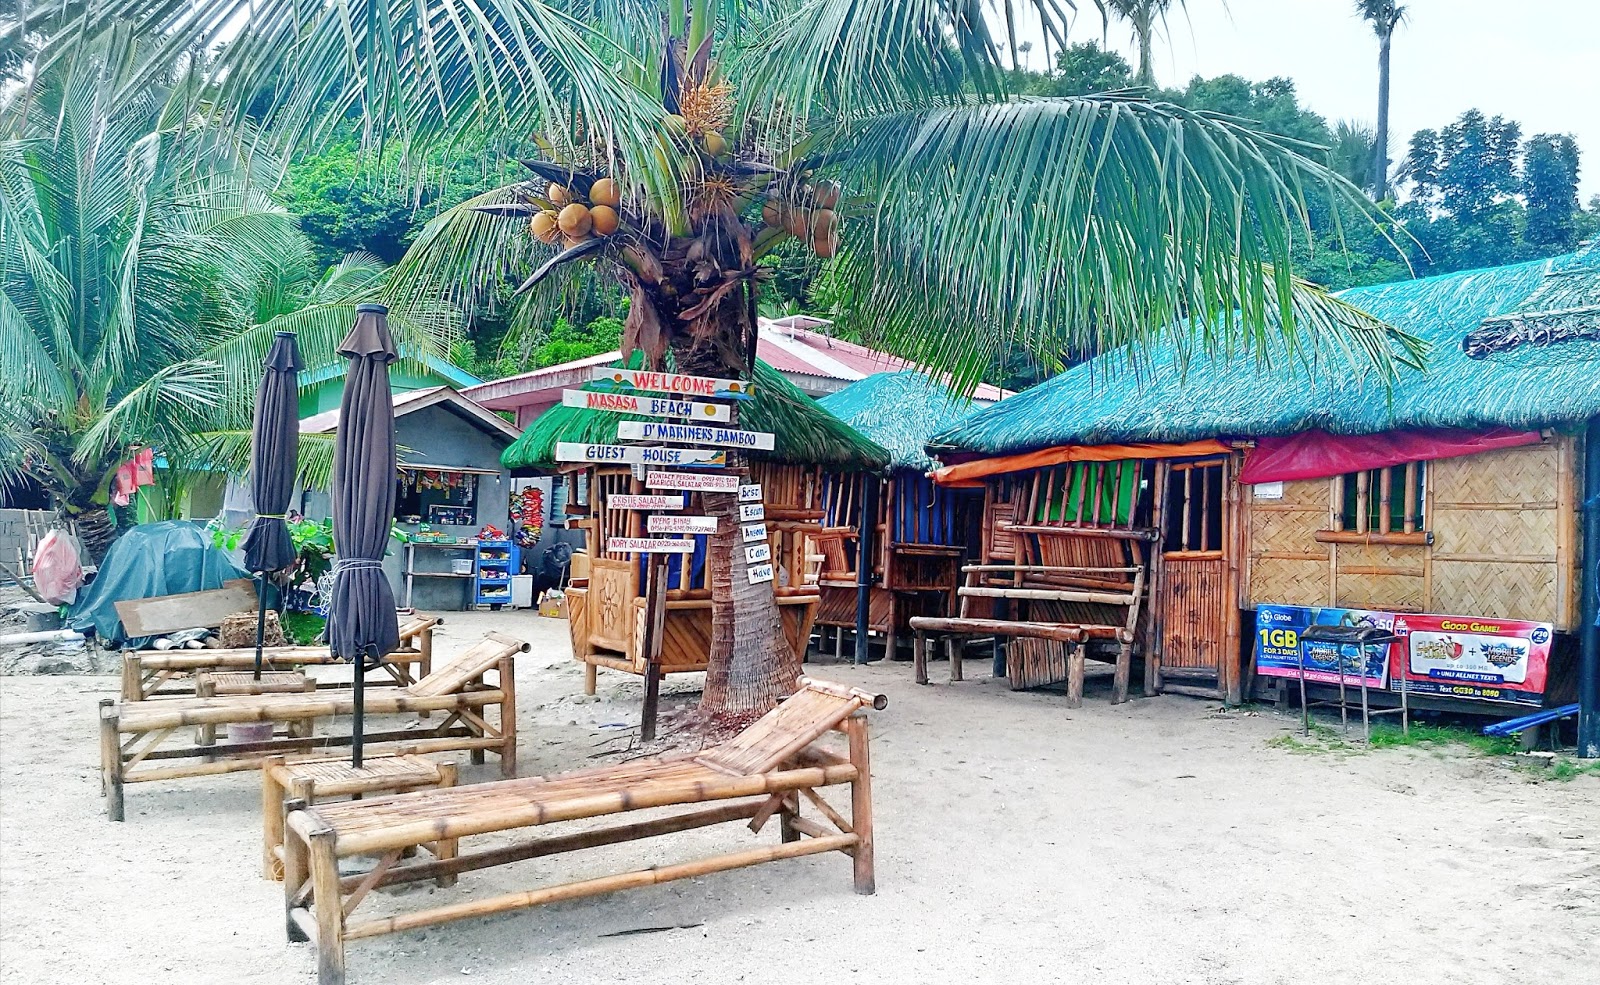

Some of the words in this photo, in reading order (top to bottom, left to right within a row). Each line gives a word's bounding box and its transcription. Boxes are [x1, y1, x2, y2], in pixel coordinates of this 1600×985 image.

[632, 372, 716, 395] WELCOME
[586, 392, 638, 410] MASASA
[651, 400, 693, 416] BEACH
[714, 429, 757, 446] BAMBOO
[586, 446, 626, 459] GUEST
[643, 449, 681, 463] HOUSE
[649, 472, 675, 480] CONTACT
[676, 473, 697, 481] PERSON
[677, 480, 702, 488] SALAZAR
[742, 487, 759, 497] Best
[638, 496, 666, 504] SALAZAR
[629, 540, 657, 549] SALAZAR
[753, 567, 771, 578] Have
[1273, 613, 1292, 622] Globe
[1259, 629, 1298, 649] 1GB
[1282, 648, 1298, 656] DAYS
[1487, 646, 1518, 657] MOBILE
[1487, 654, 1517, 665] LEGENDS
[1456, 672, 1480, 680] ALLNET
[1439, 685, 1452, 693] Text
[1453, 687, 1474, 695] GG30
